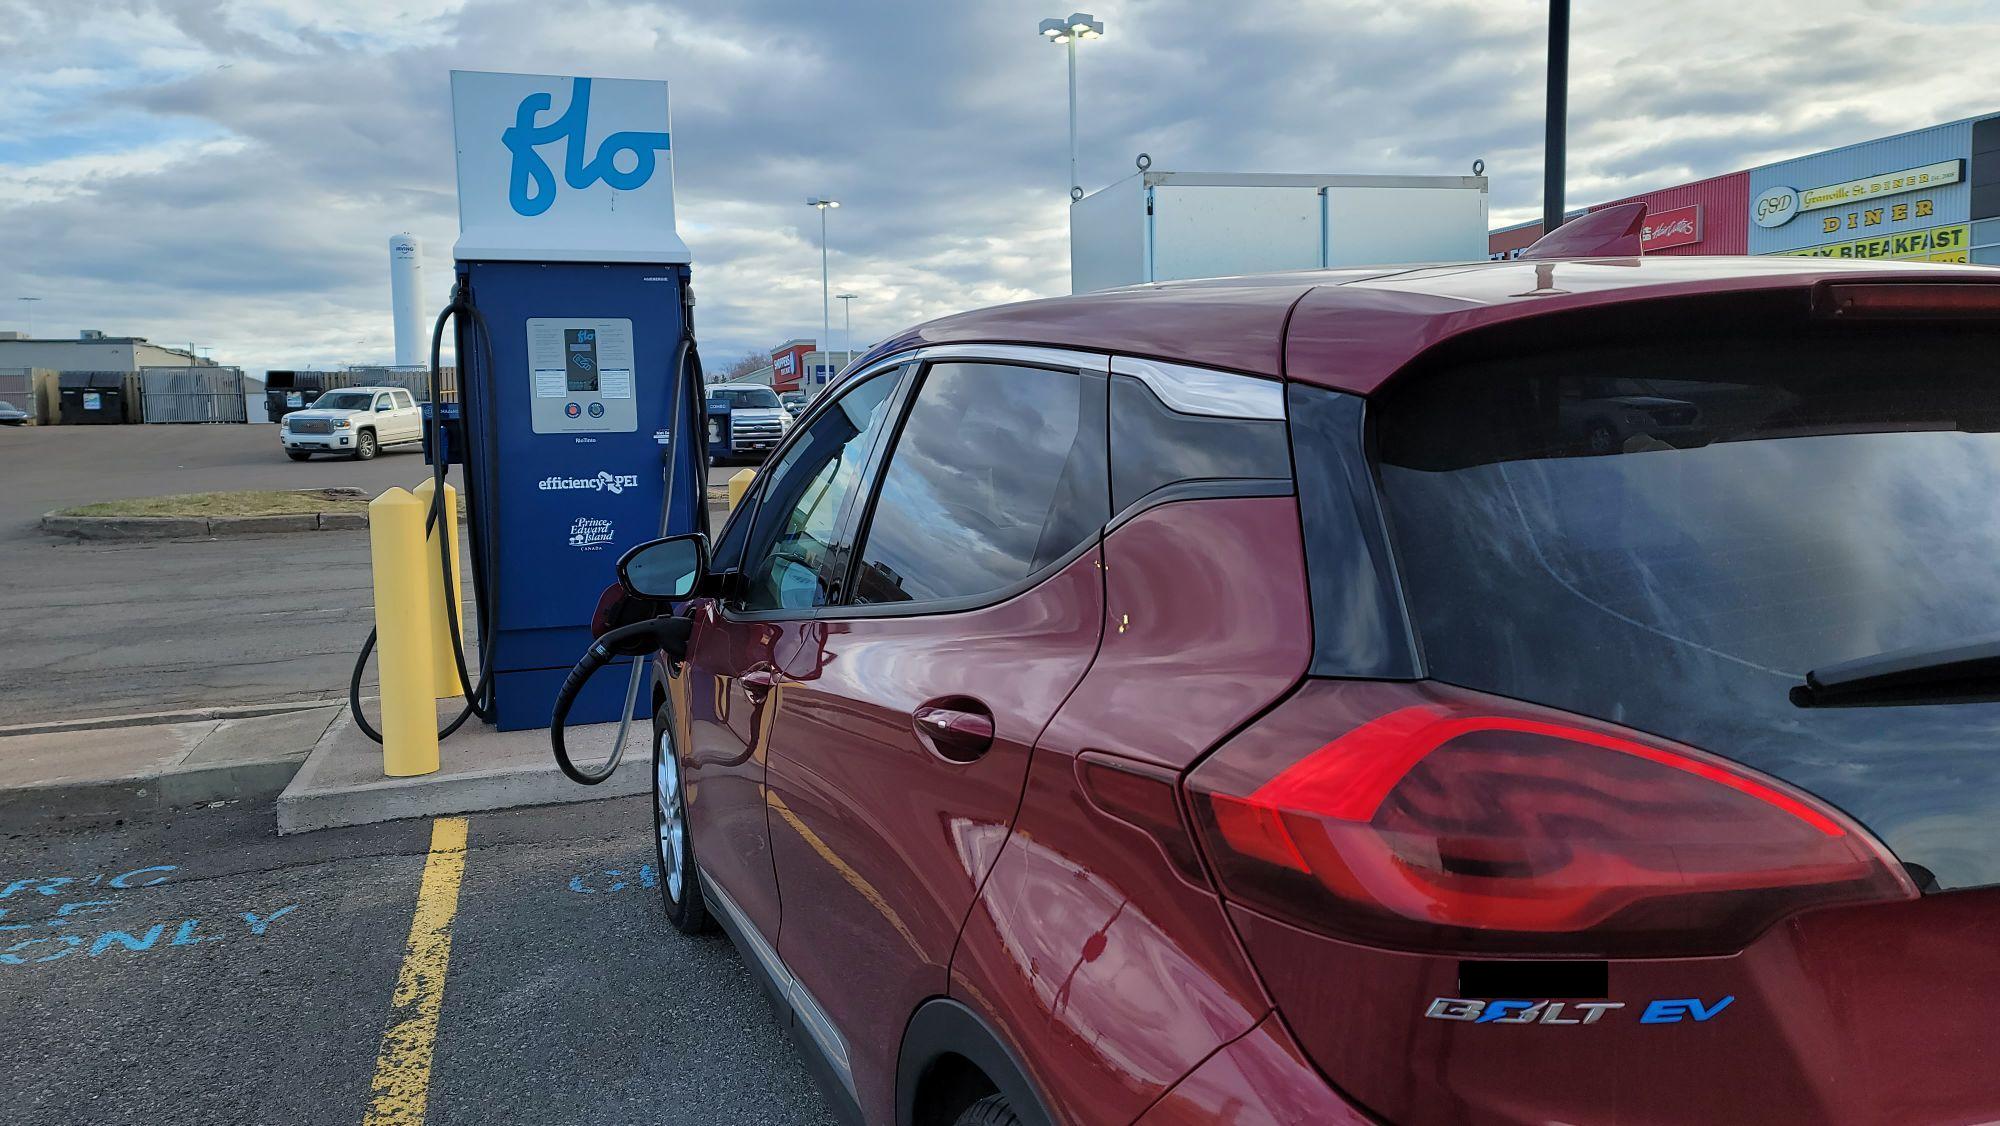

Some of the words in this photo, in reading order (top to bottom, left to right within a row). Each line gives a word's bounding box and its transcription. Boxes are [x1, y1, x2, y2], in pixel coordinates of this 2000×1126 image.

[501, 77, 670, 216] flo
[1804, 187, 1849, 208] Granville
[1852, 185, 1866, 196] St.
[1870, 174, 1929, 193] DINER
[1758, 195, 1792, 221] GSD
[1823, 200, 1933, 233] DINER
[1841, 229, 1962, 259] BREAKFAST
[577, 330, 594, 343] flo
[538, 476, 604, 491] efficiency
[615, 475, 638, 487] PEI
[570, 523, 609, 535] Edward
[575, 517, 613, 527] Prince
[584, 530, 614, 543] Island
[0, 902, 299, 964] ONLY
[1424, 997, 1626, 1025] BOLT
[1639, 995, 1736, 1025] EV
